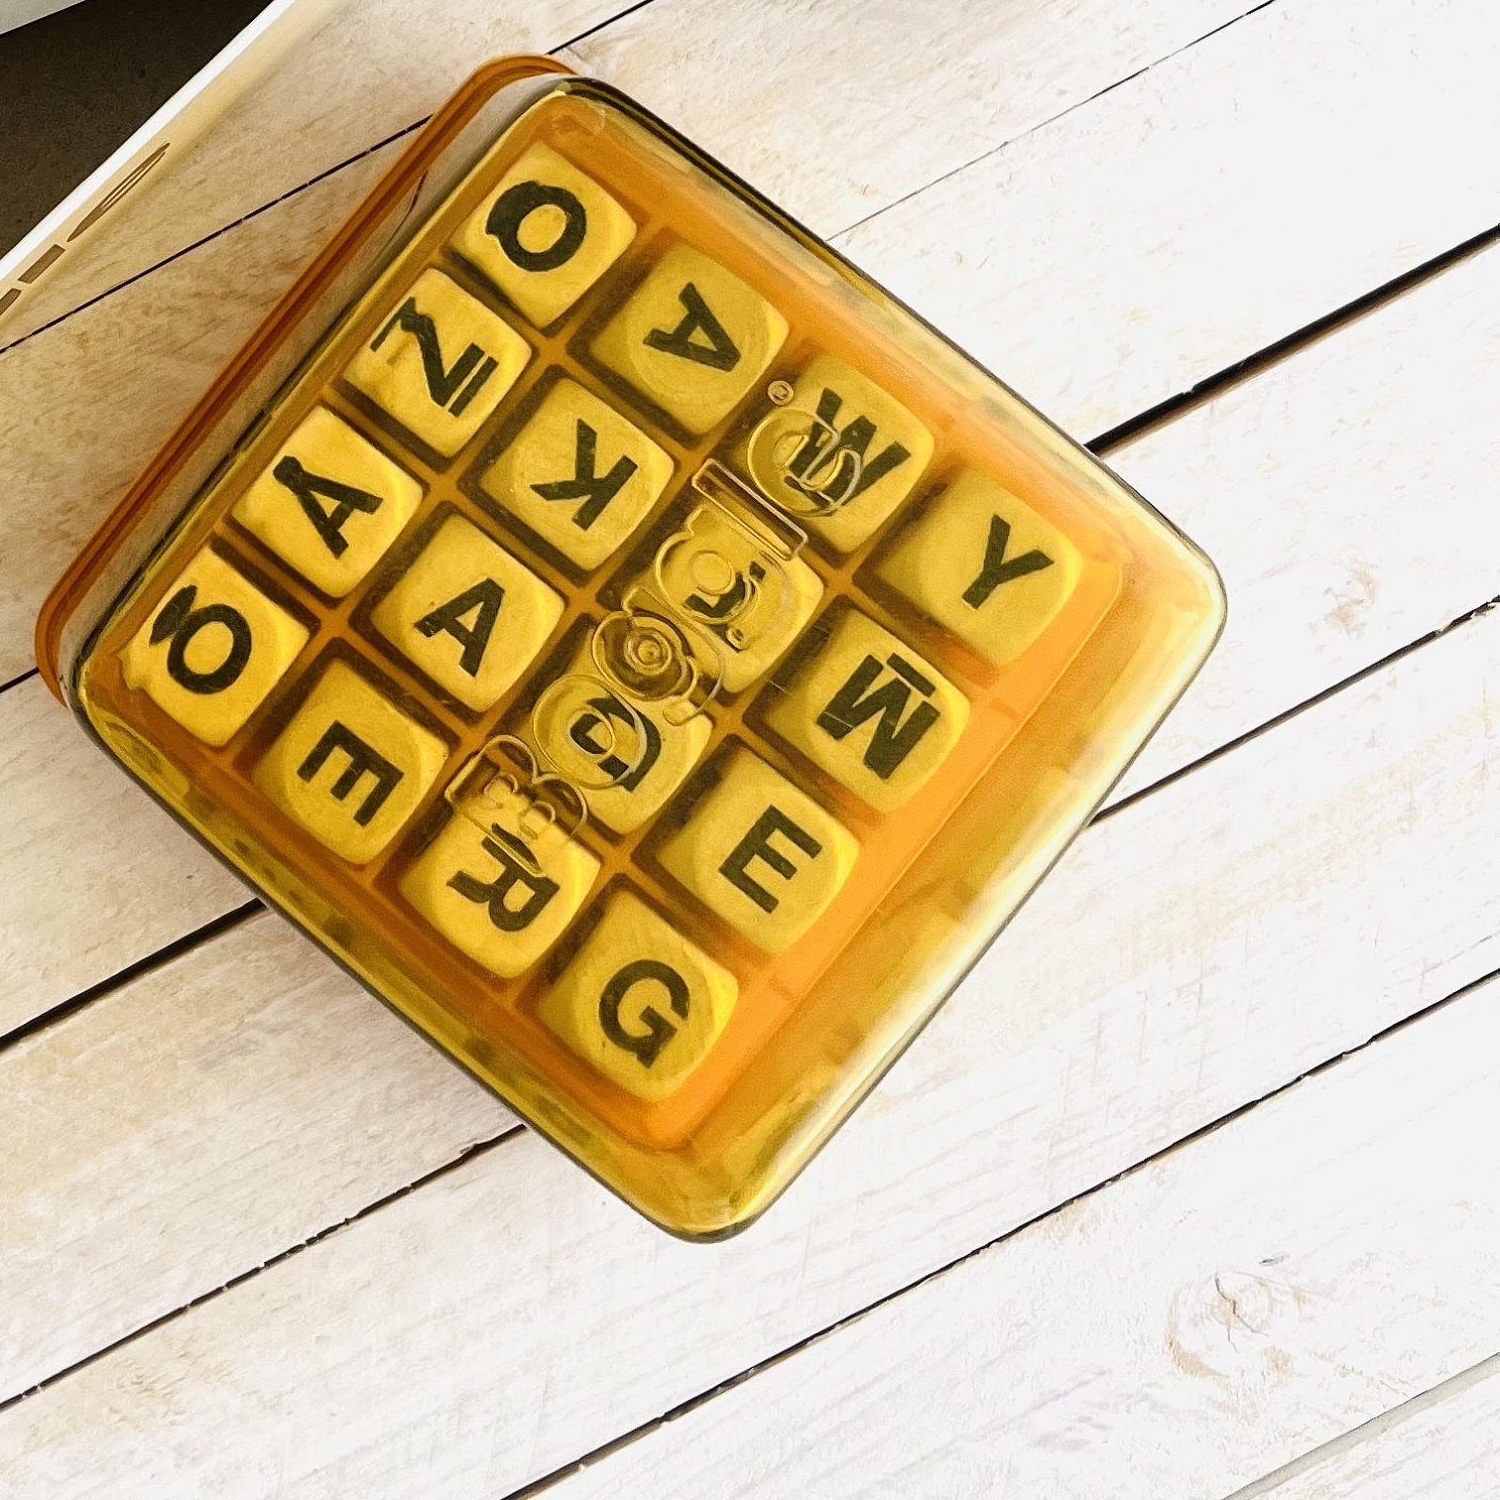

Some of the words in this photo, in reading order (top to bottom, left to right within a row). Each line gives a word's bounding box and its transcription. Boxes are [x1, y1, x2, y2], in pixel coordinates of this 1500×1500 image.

[273, 456, 383, 559] A
[296, 720, 404, 828] E
[414, 577, 506, 678] A
[530, 418, 638, 531] K
[643, 282, 741, 372] A
[446, 823, 562, 934] R
[599, 959, 691, 1069] G
[719, 805, 824, 915] E
[961, 513, 1054, 610] Y
